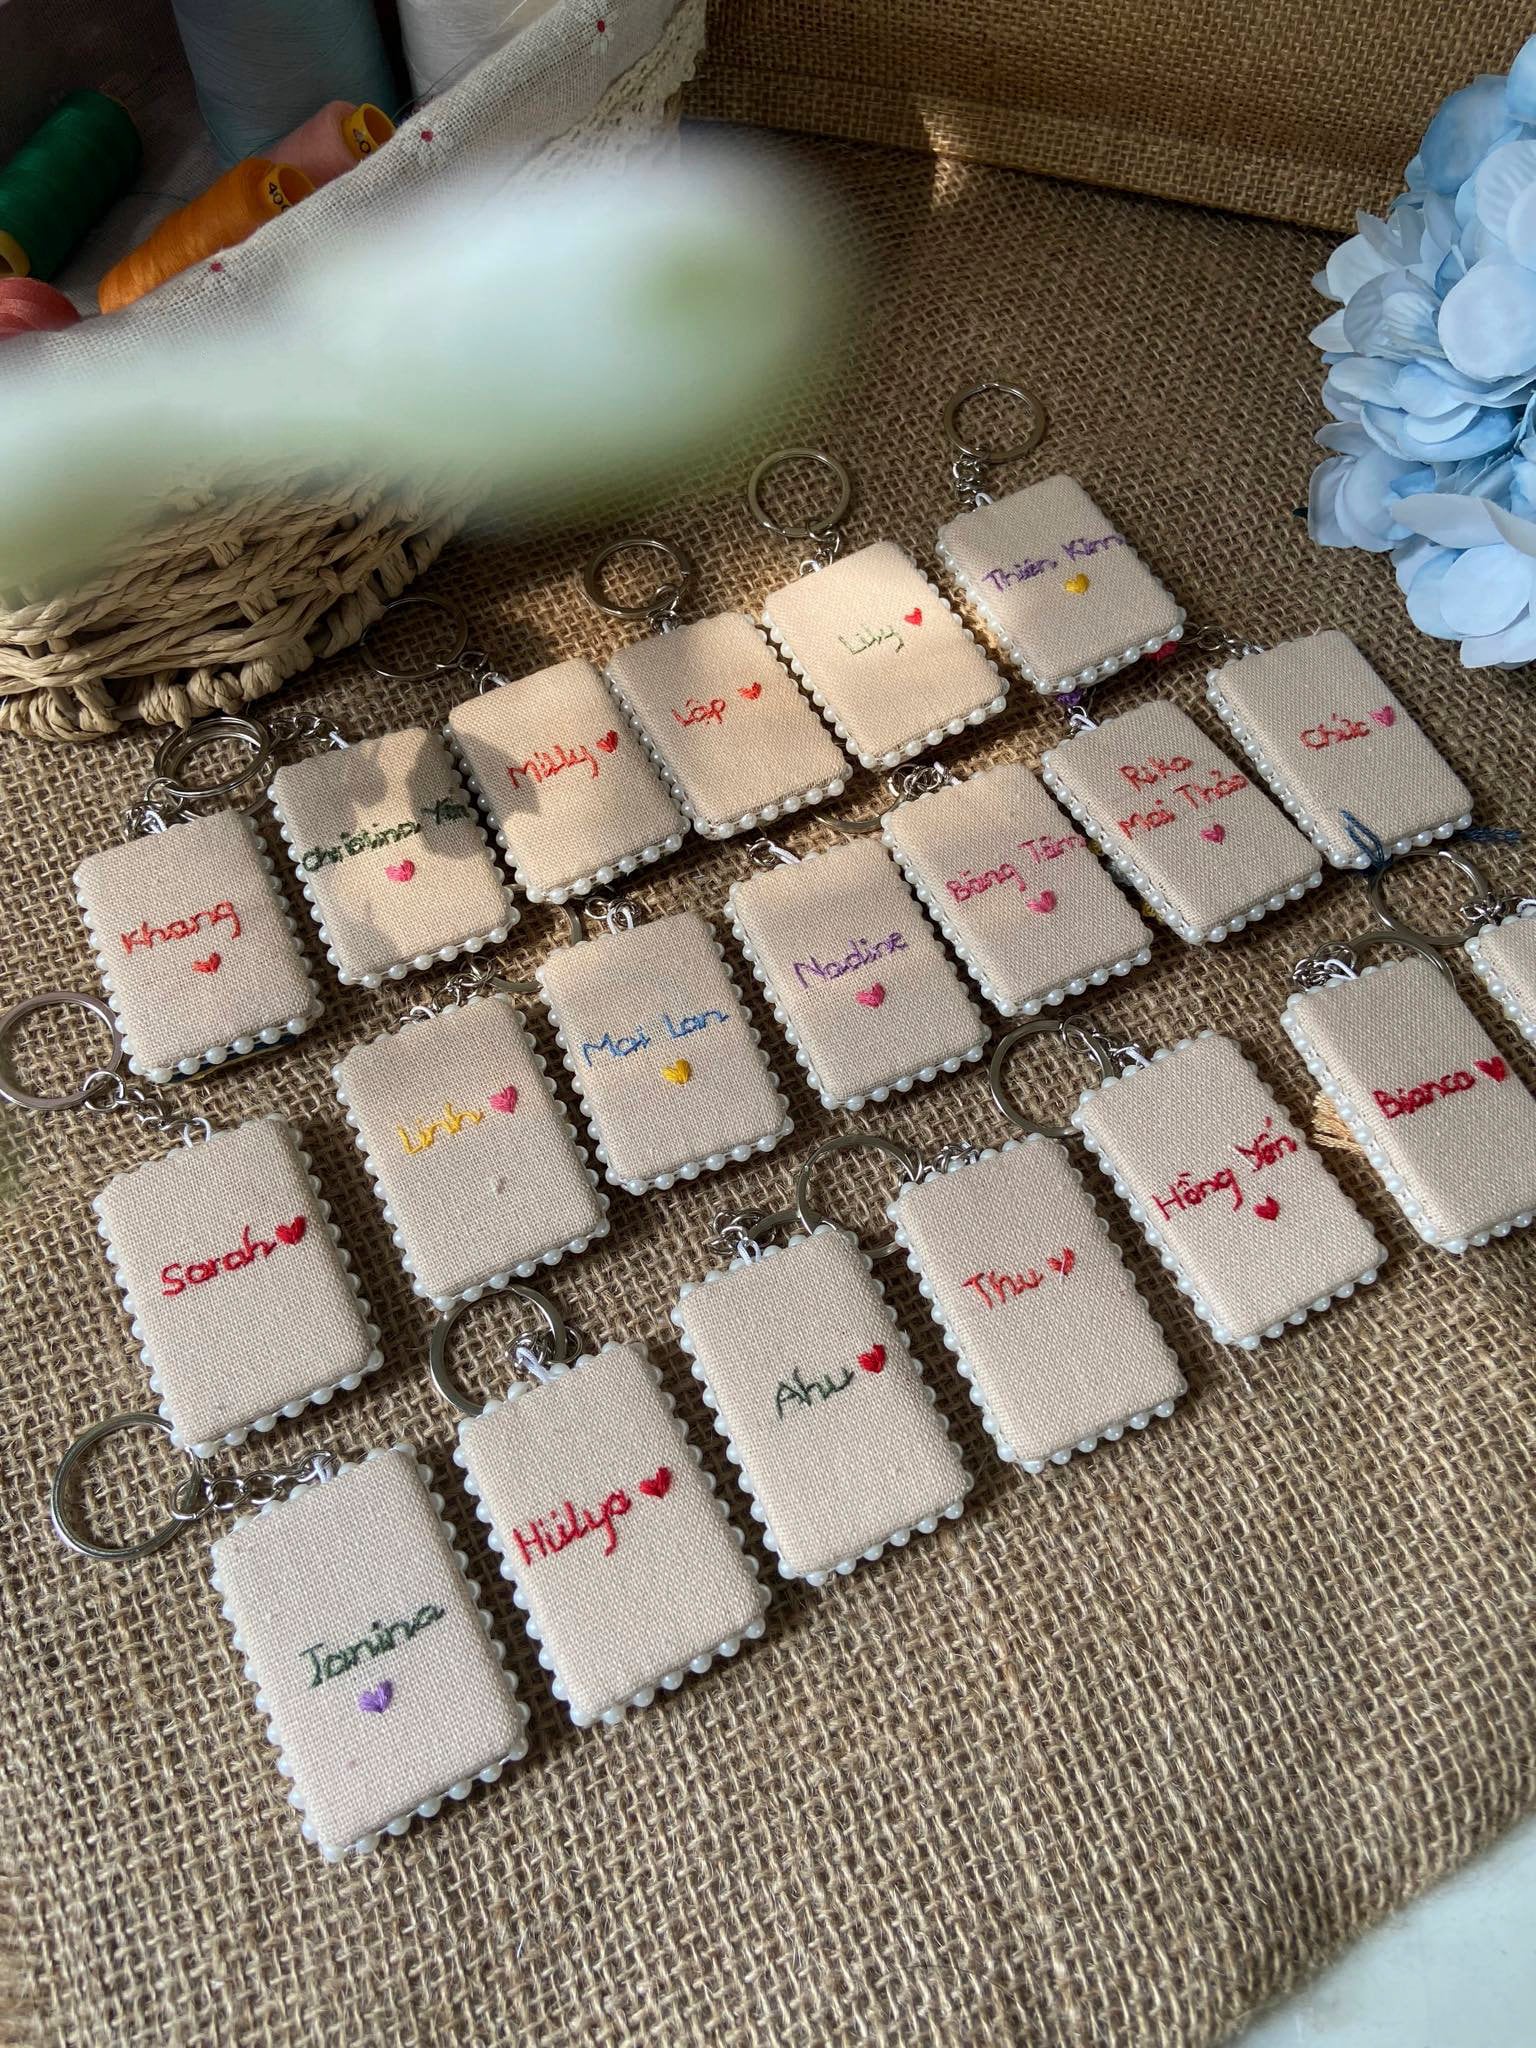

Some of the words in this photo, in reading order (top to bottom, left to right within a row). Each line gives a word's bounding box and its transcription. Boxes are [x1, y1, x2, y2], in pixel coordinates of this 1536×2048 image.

[838, 623, 905, 655] Lily
[1118, 799, 1177, 840] Mai
[120, 900, 242, 955] Khang
[793, 932, 909, 989] Nadine
[582, 1024, 651, 1067] Mai
[662, 1009, 729, 1038] Lan
[396, 1103, 486, 1155] Linh
[161, 1224, 277, 1296] Sarah
[962, 1268, 1046, 1310] Thu
[776, 1366, 855, 1421] Ahu
[512, 1489, 632, 1566] Hülya
[299, 1605, 446, 1688] Janina
